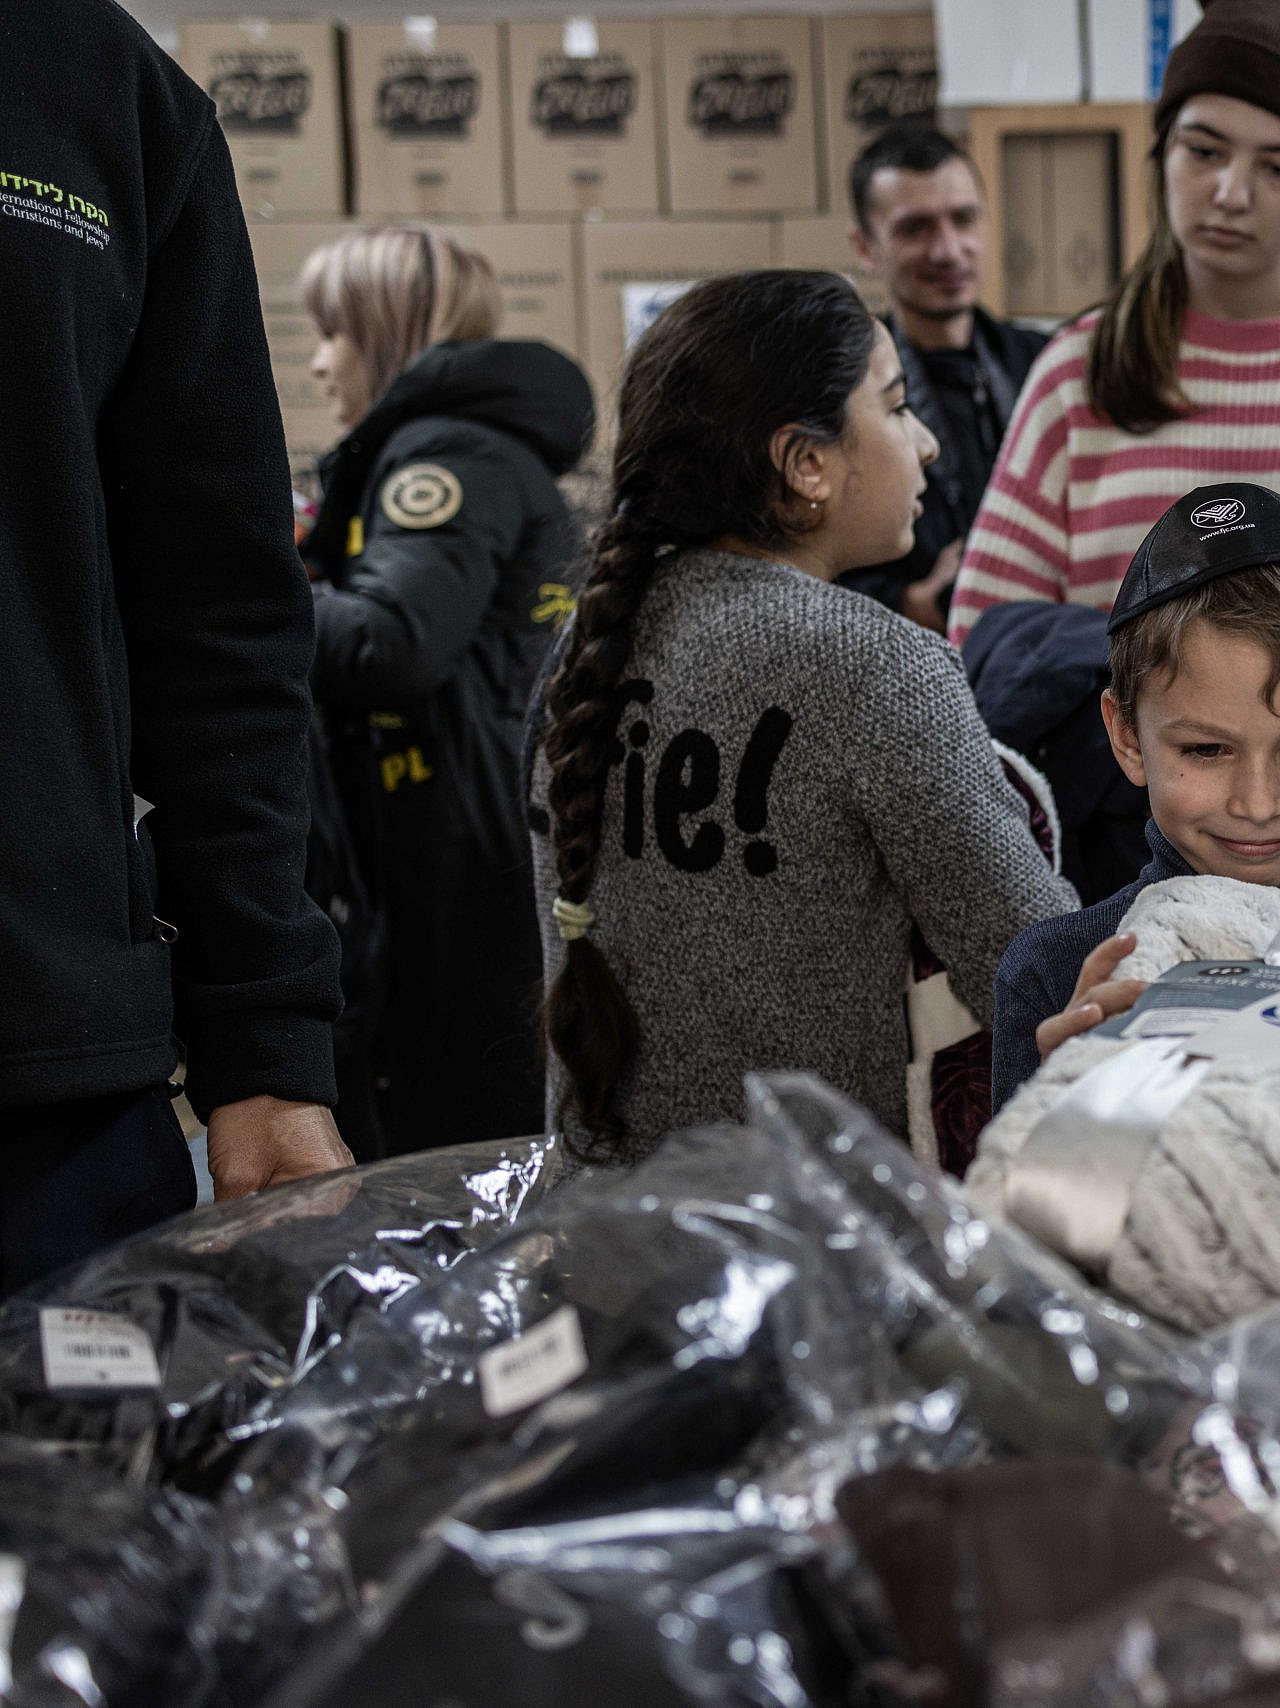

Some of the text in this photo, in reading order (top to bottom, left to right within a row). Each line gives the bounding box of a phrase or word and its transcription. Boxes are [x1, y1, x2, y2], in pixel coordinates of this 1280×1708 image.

[0, 171, 108, 227] הקרן לידידו
[2, 204, 104, 250] Christians and Jews
[64, 209, 110, 246] Fellowship
